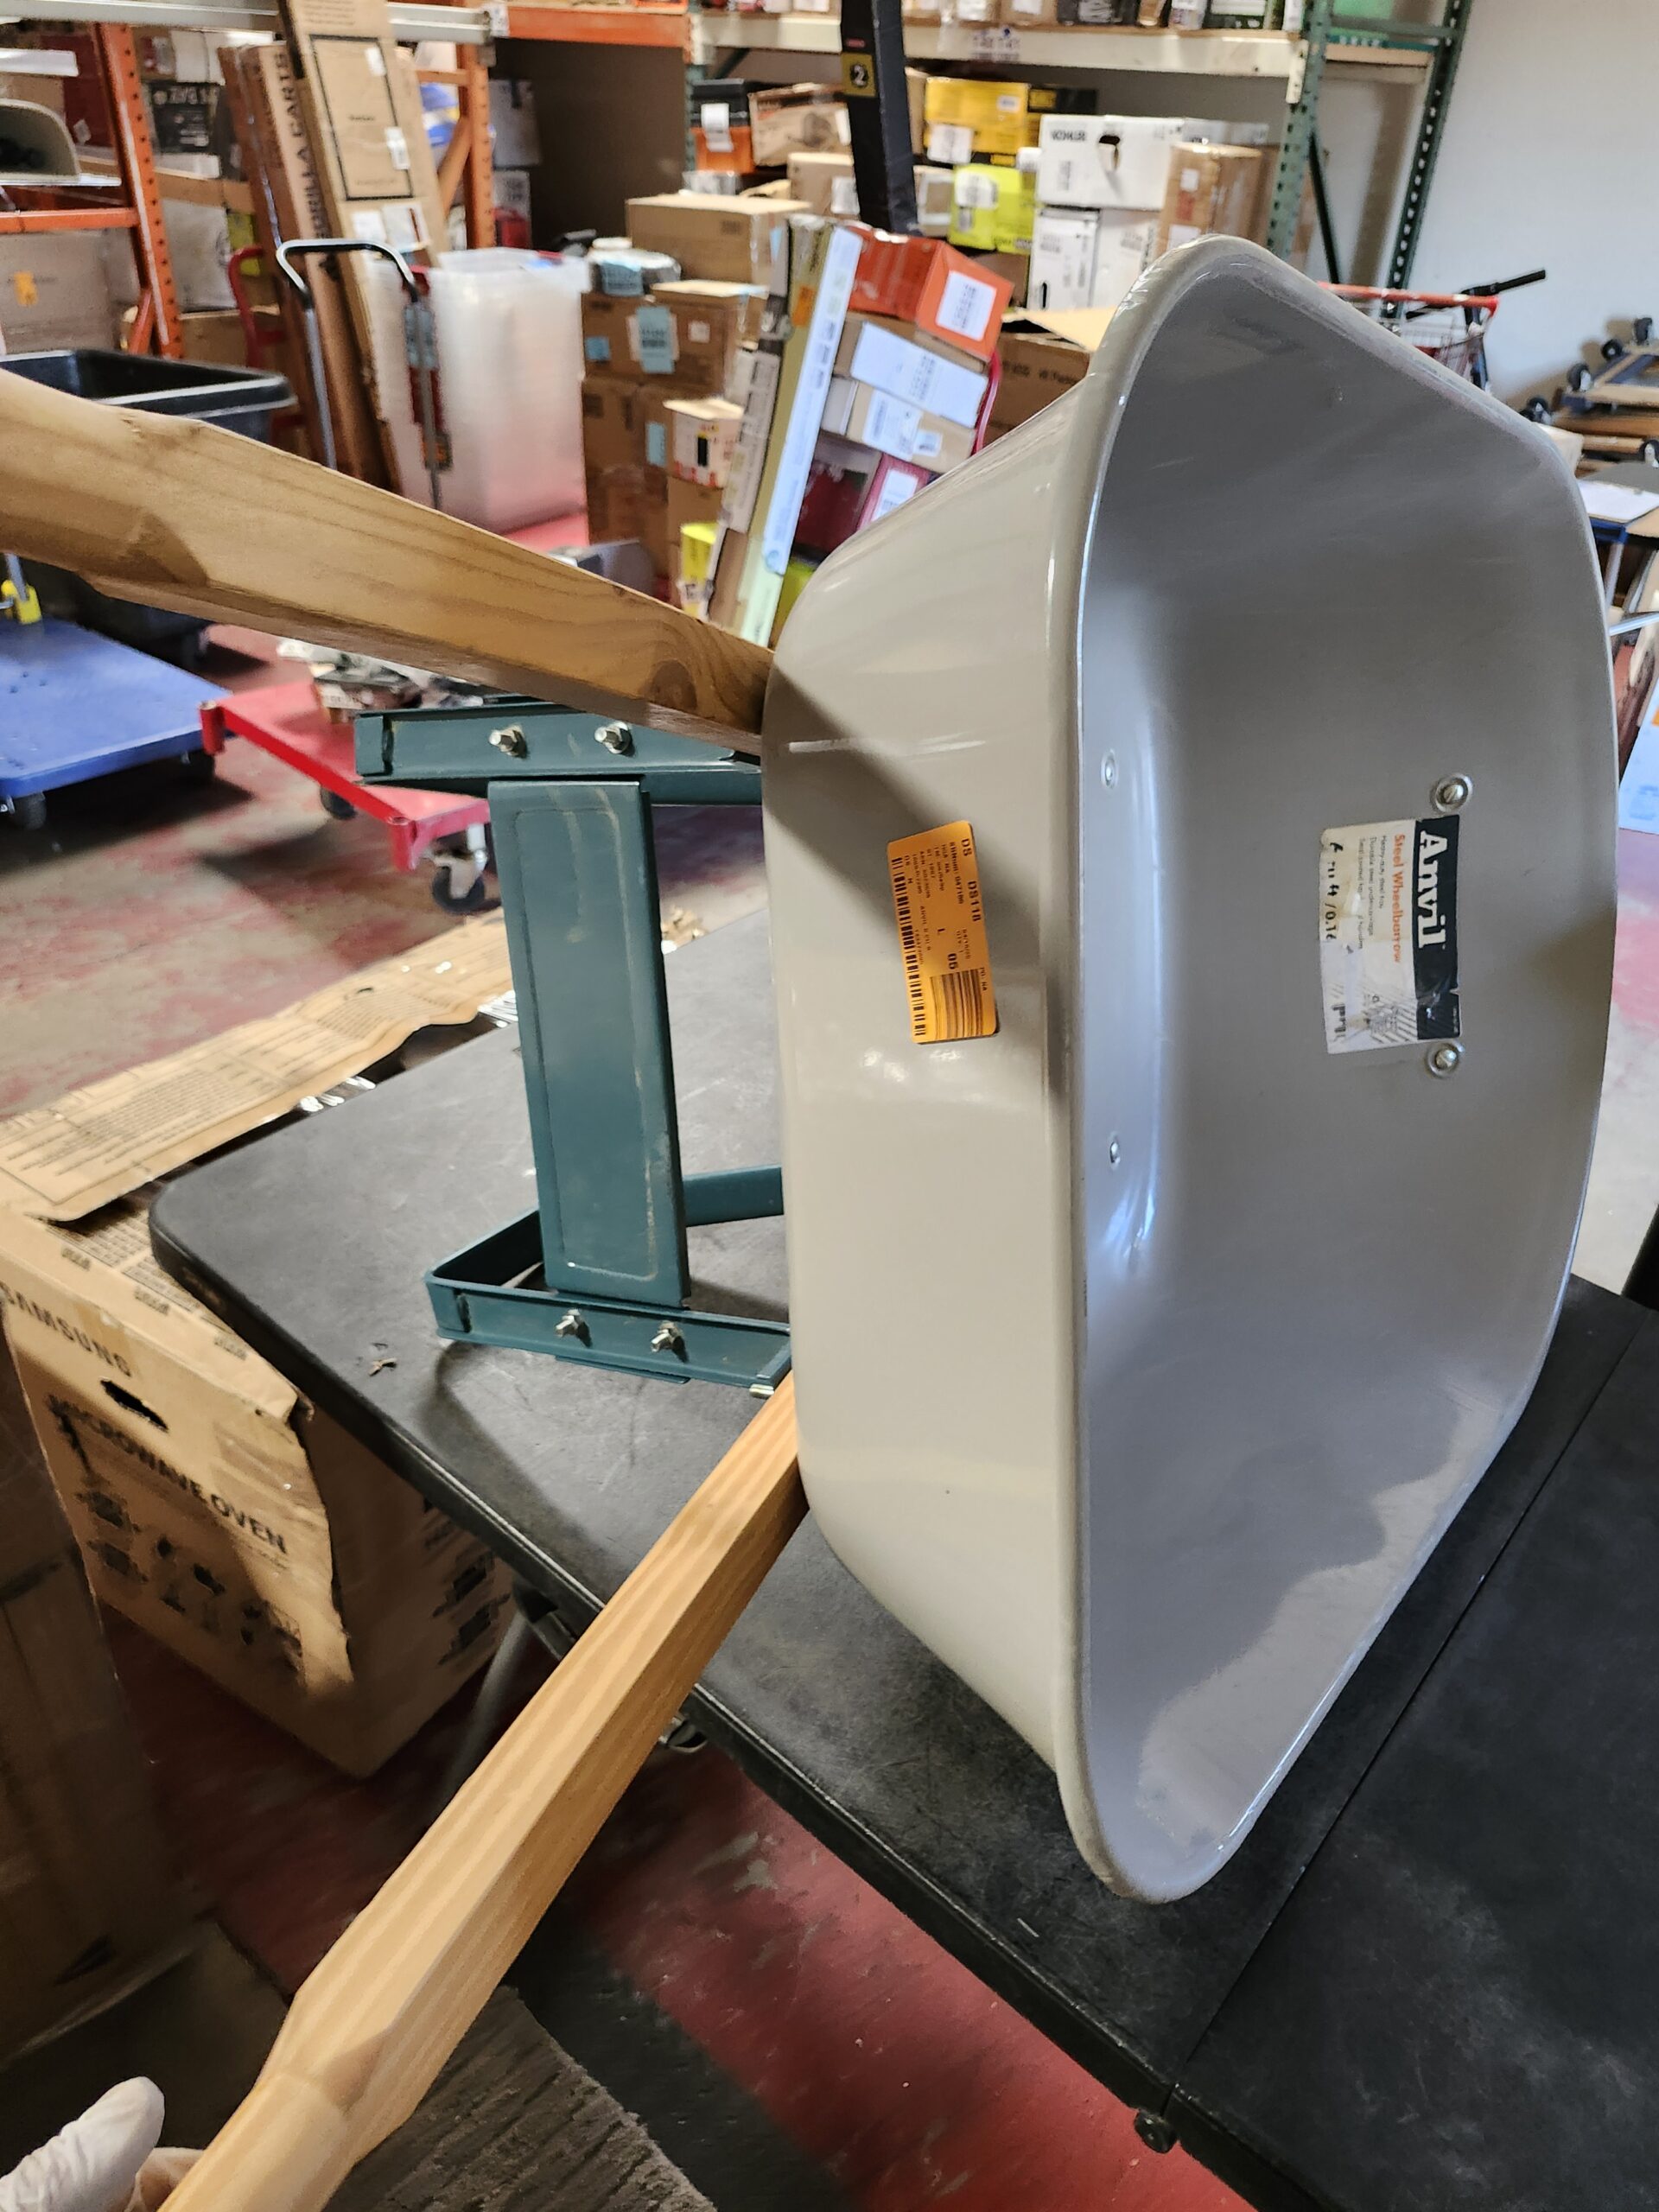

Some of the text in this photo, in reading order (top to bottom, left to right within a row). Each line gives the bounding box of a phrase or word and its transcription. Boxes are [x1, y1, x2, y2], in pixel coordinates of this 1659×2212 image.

[852, 65, 867, 86] 2
[1391, 834, 1405, 963] Steel Wheelbarrow
[1418, 830, 1447, 949] Anvil
[0, 1280, 132, 1377] SAMSUNG
[210, 1493, 289, 1555] OVEN
